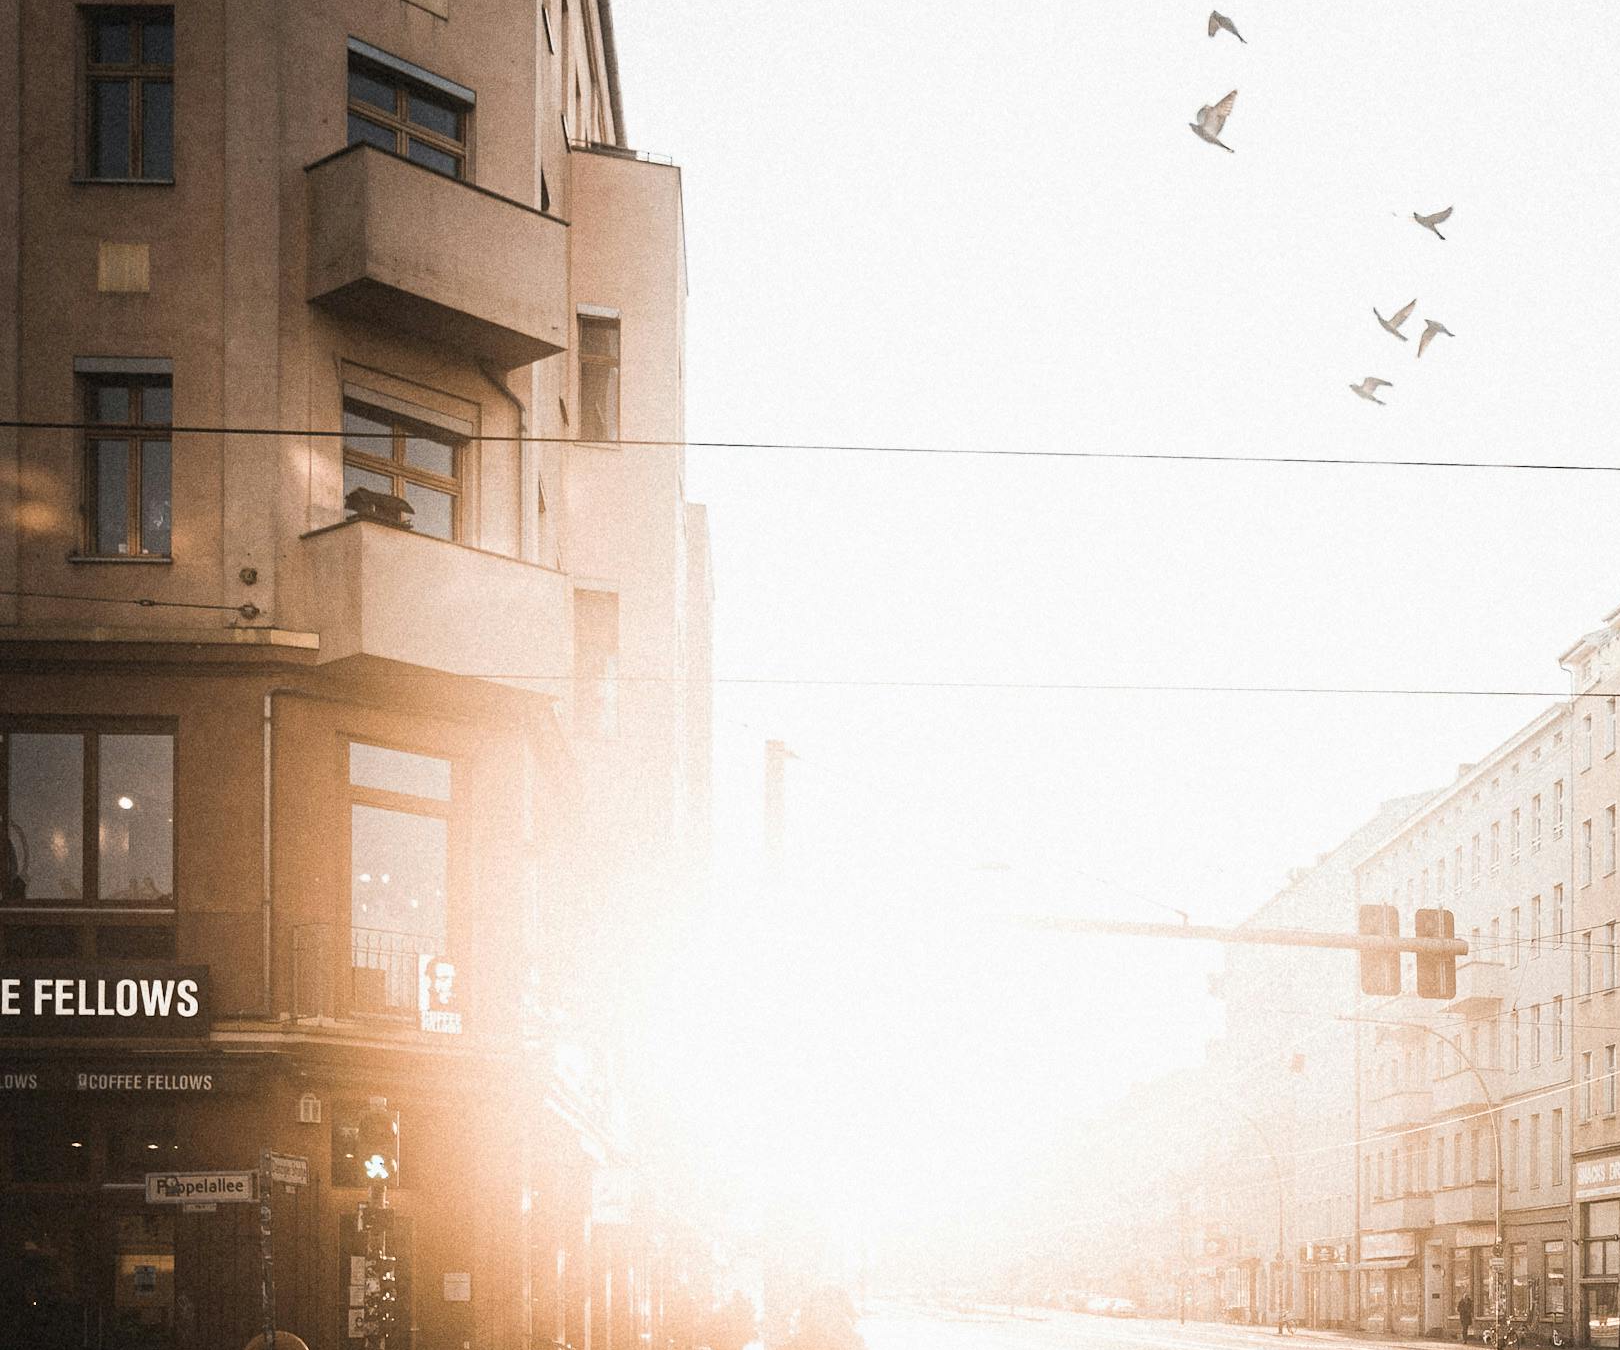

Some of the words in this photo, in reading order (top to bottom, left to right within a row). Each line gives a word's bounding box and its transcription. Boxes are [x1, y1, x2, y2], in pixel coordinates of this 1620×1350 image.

[1, 979, 20, 1015] E
[34, 979, 199, 1017] FELLOWS
[89, 1075, 142, 1090] COFFEE
[147, 1075, 213, 1090] FELLOWS
[157, 1178, 244, 1197] Pppelallee
